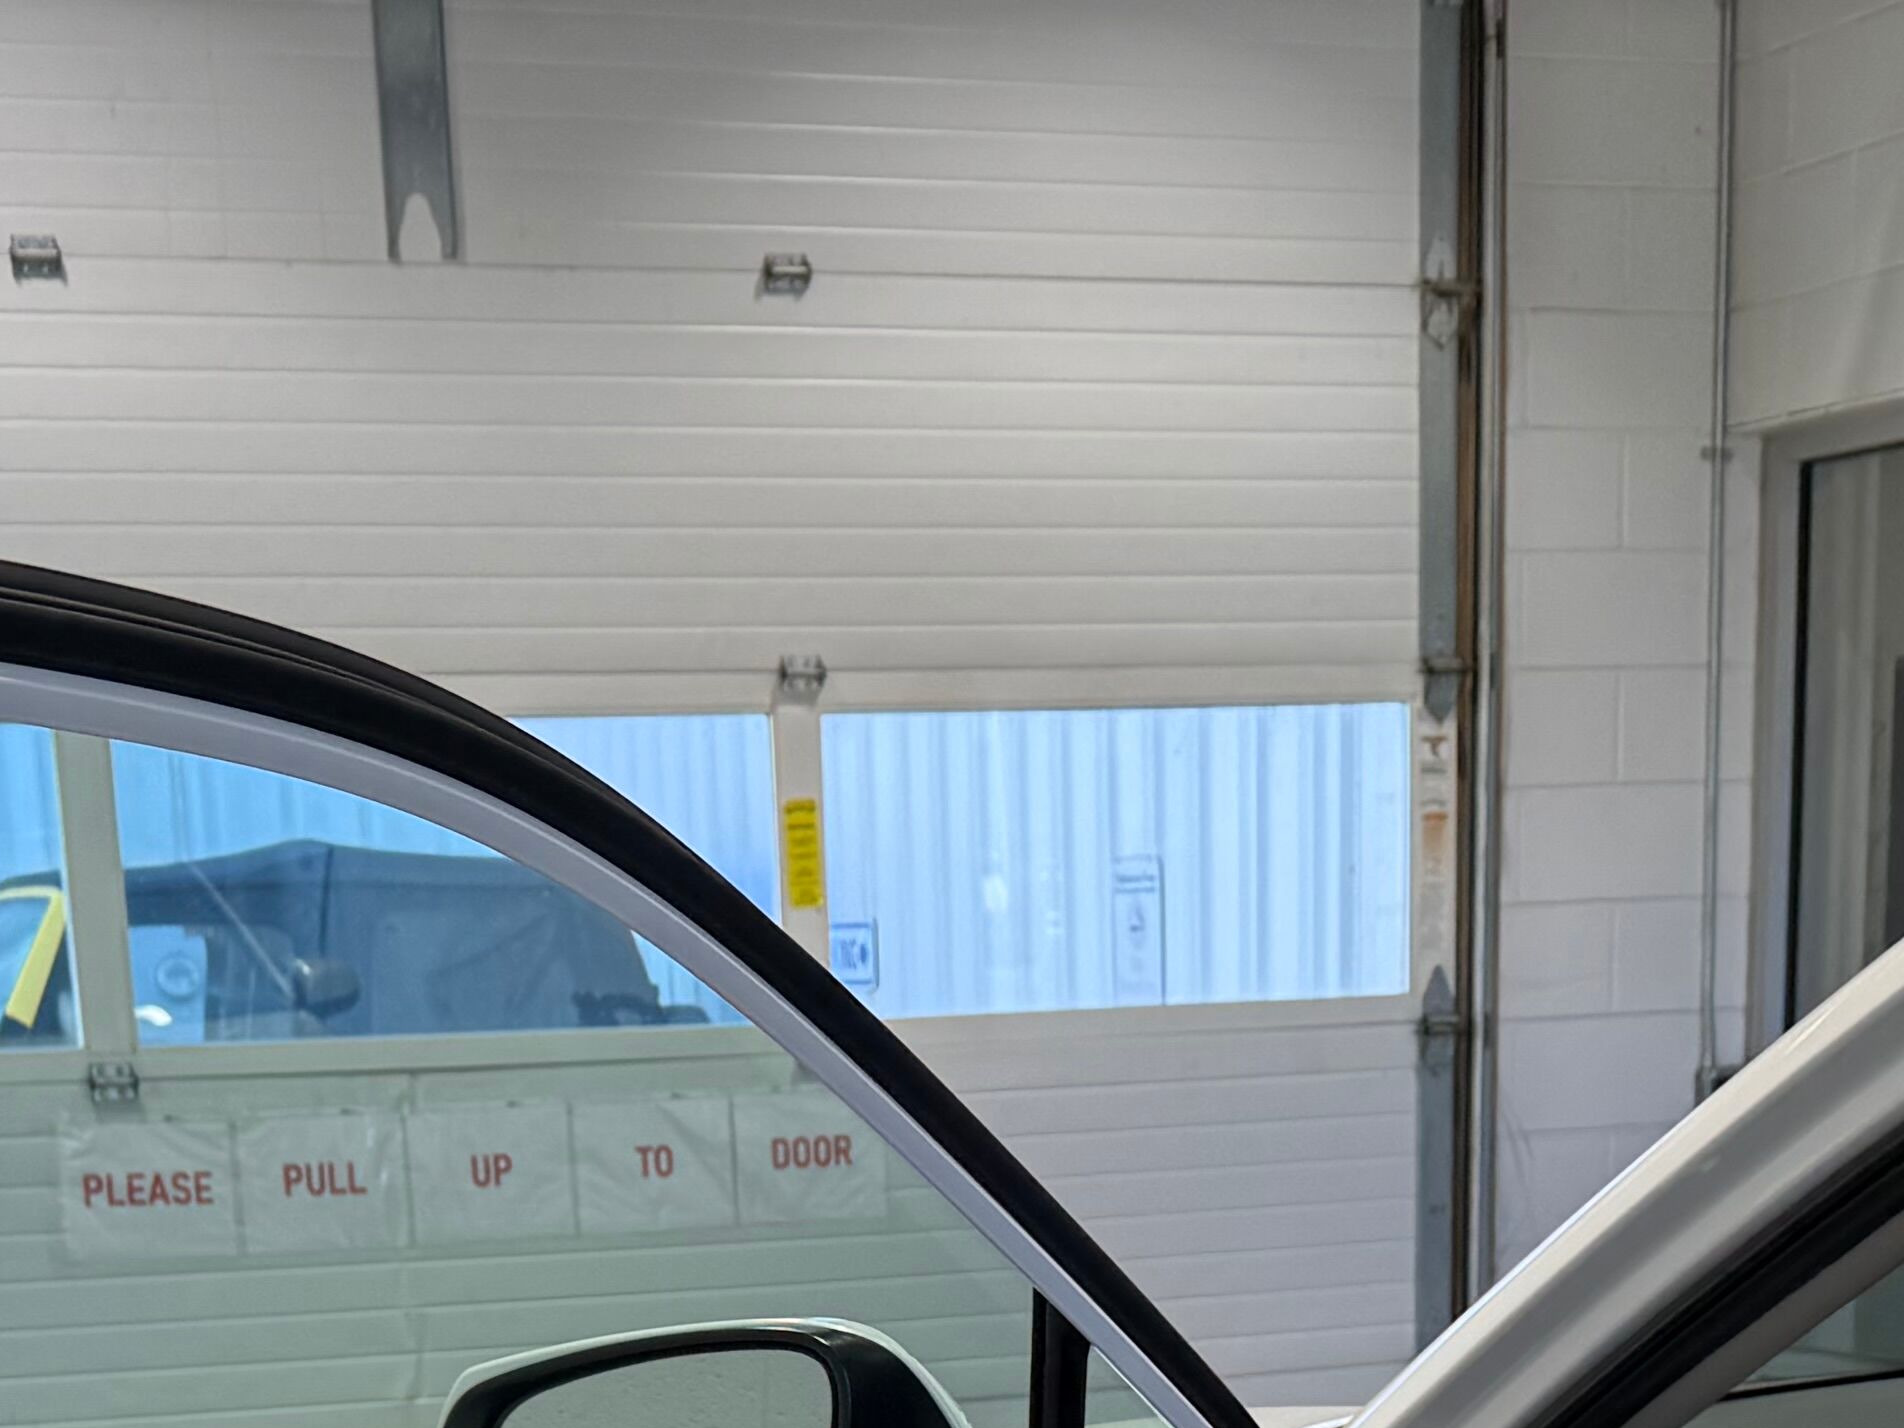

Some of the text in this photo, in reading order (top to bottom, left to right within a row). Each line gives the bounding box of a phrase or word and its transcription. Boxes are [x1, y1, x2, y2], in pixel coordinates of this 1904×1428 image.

[82, 1135, 853, 1207] PLEASE PULL UP TO DOOR
